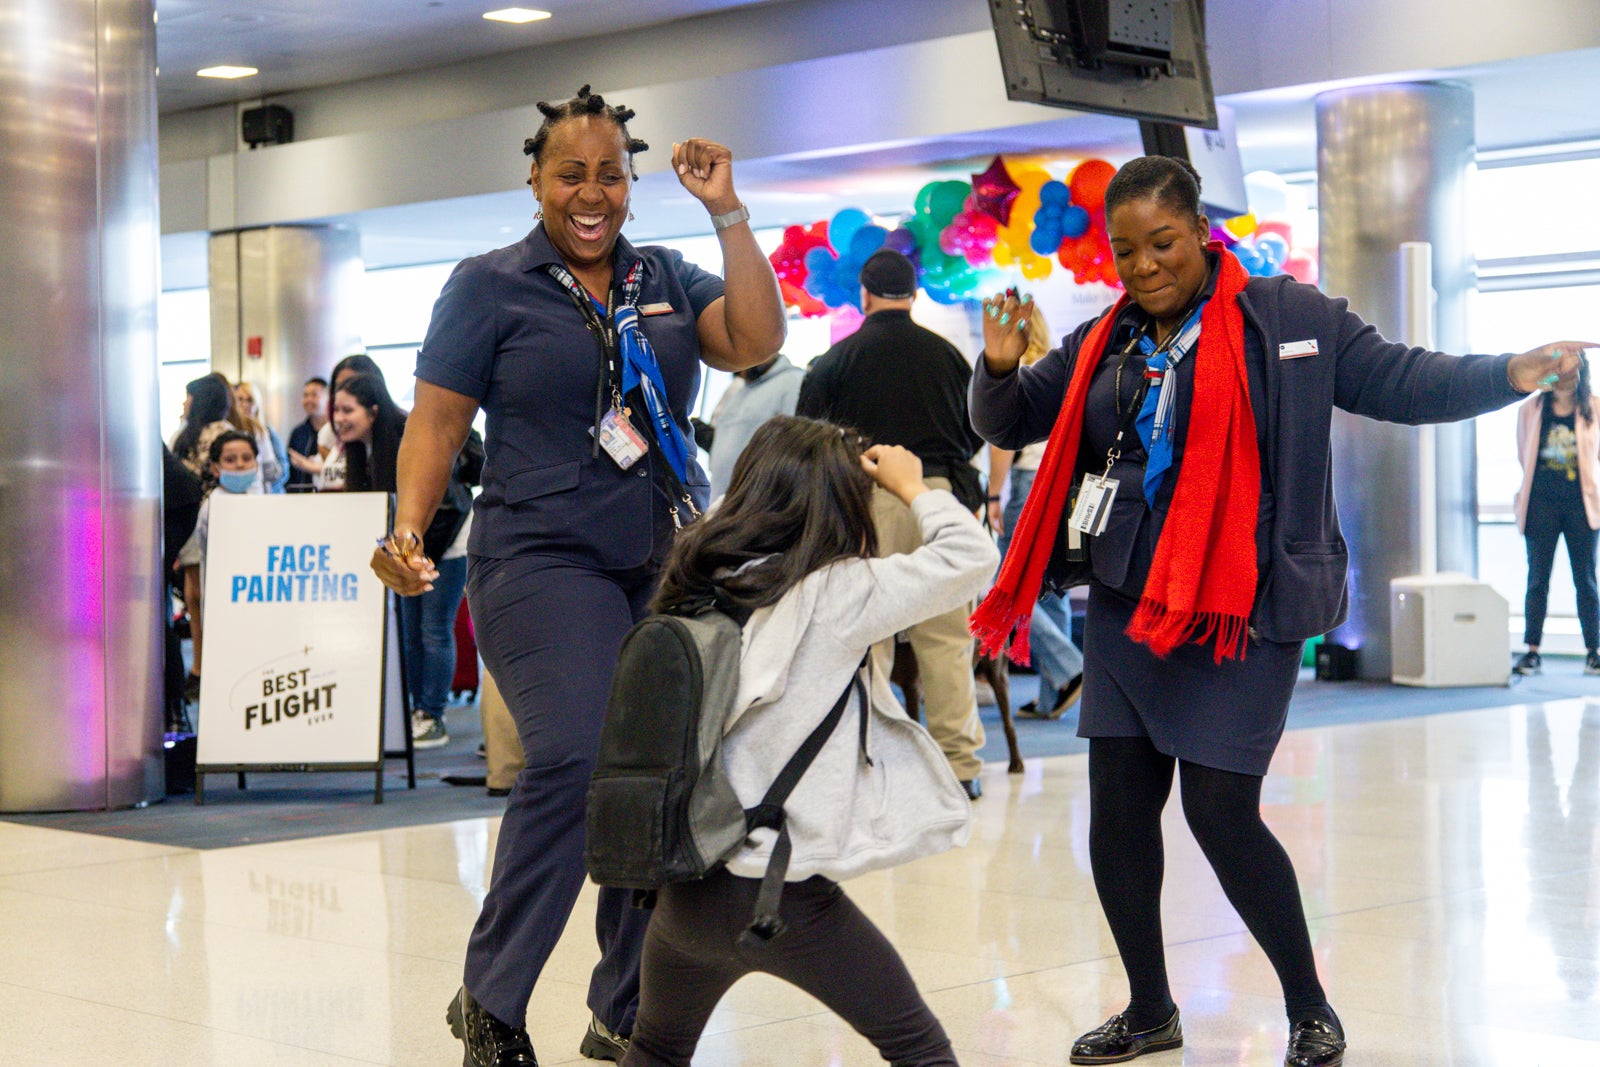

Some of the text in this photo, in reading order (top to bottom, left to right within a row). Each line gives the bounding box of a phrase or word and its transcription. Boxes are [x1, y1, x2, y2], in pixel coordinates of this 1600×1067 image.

[267, 544, 331, 573] FACE
[231, 573, 358, 603] PAINTING
[263, 667, 311, 697] BEST
[245, 683, 337, 730] FLIGHT
